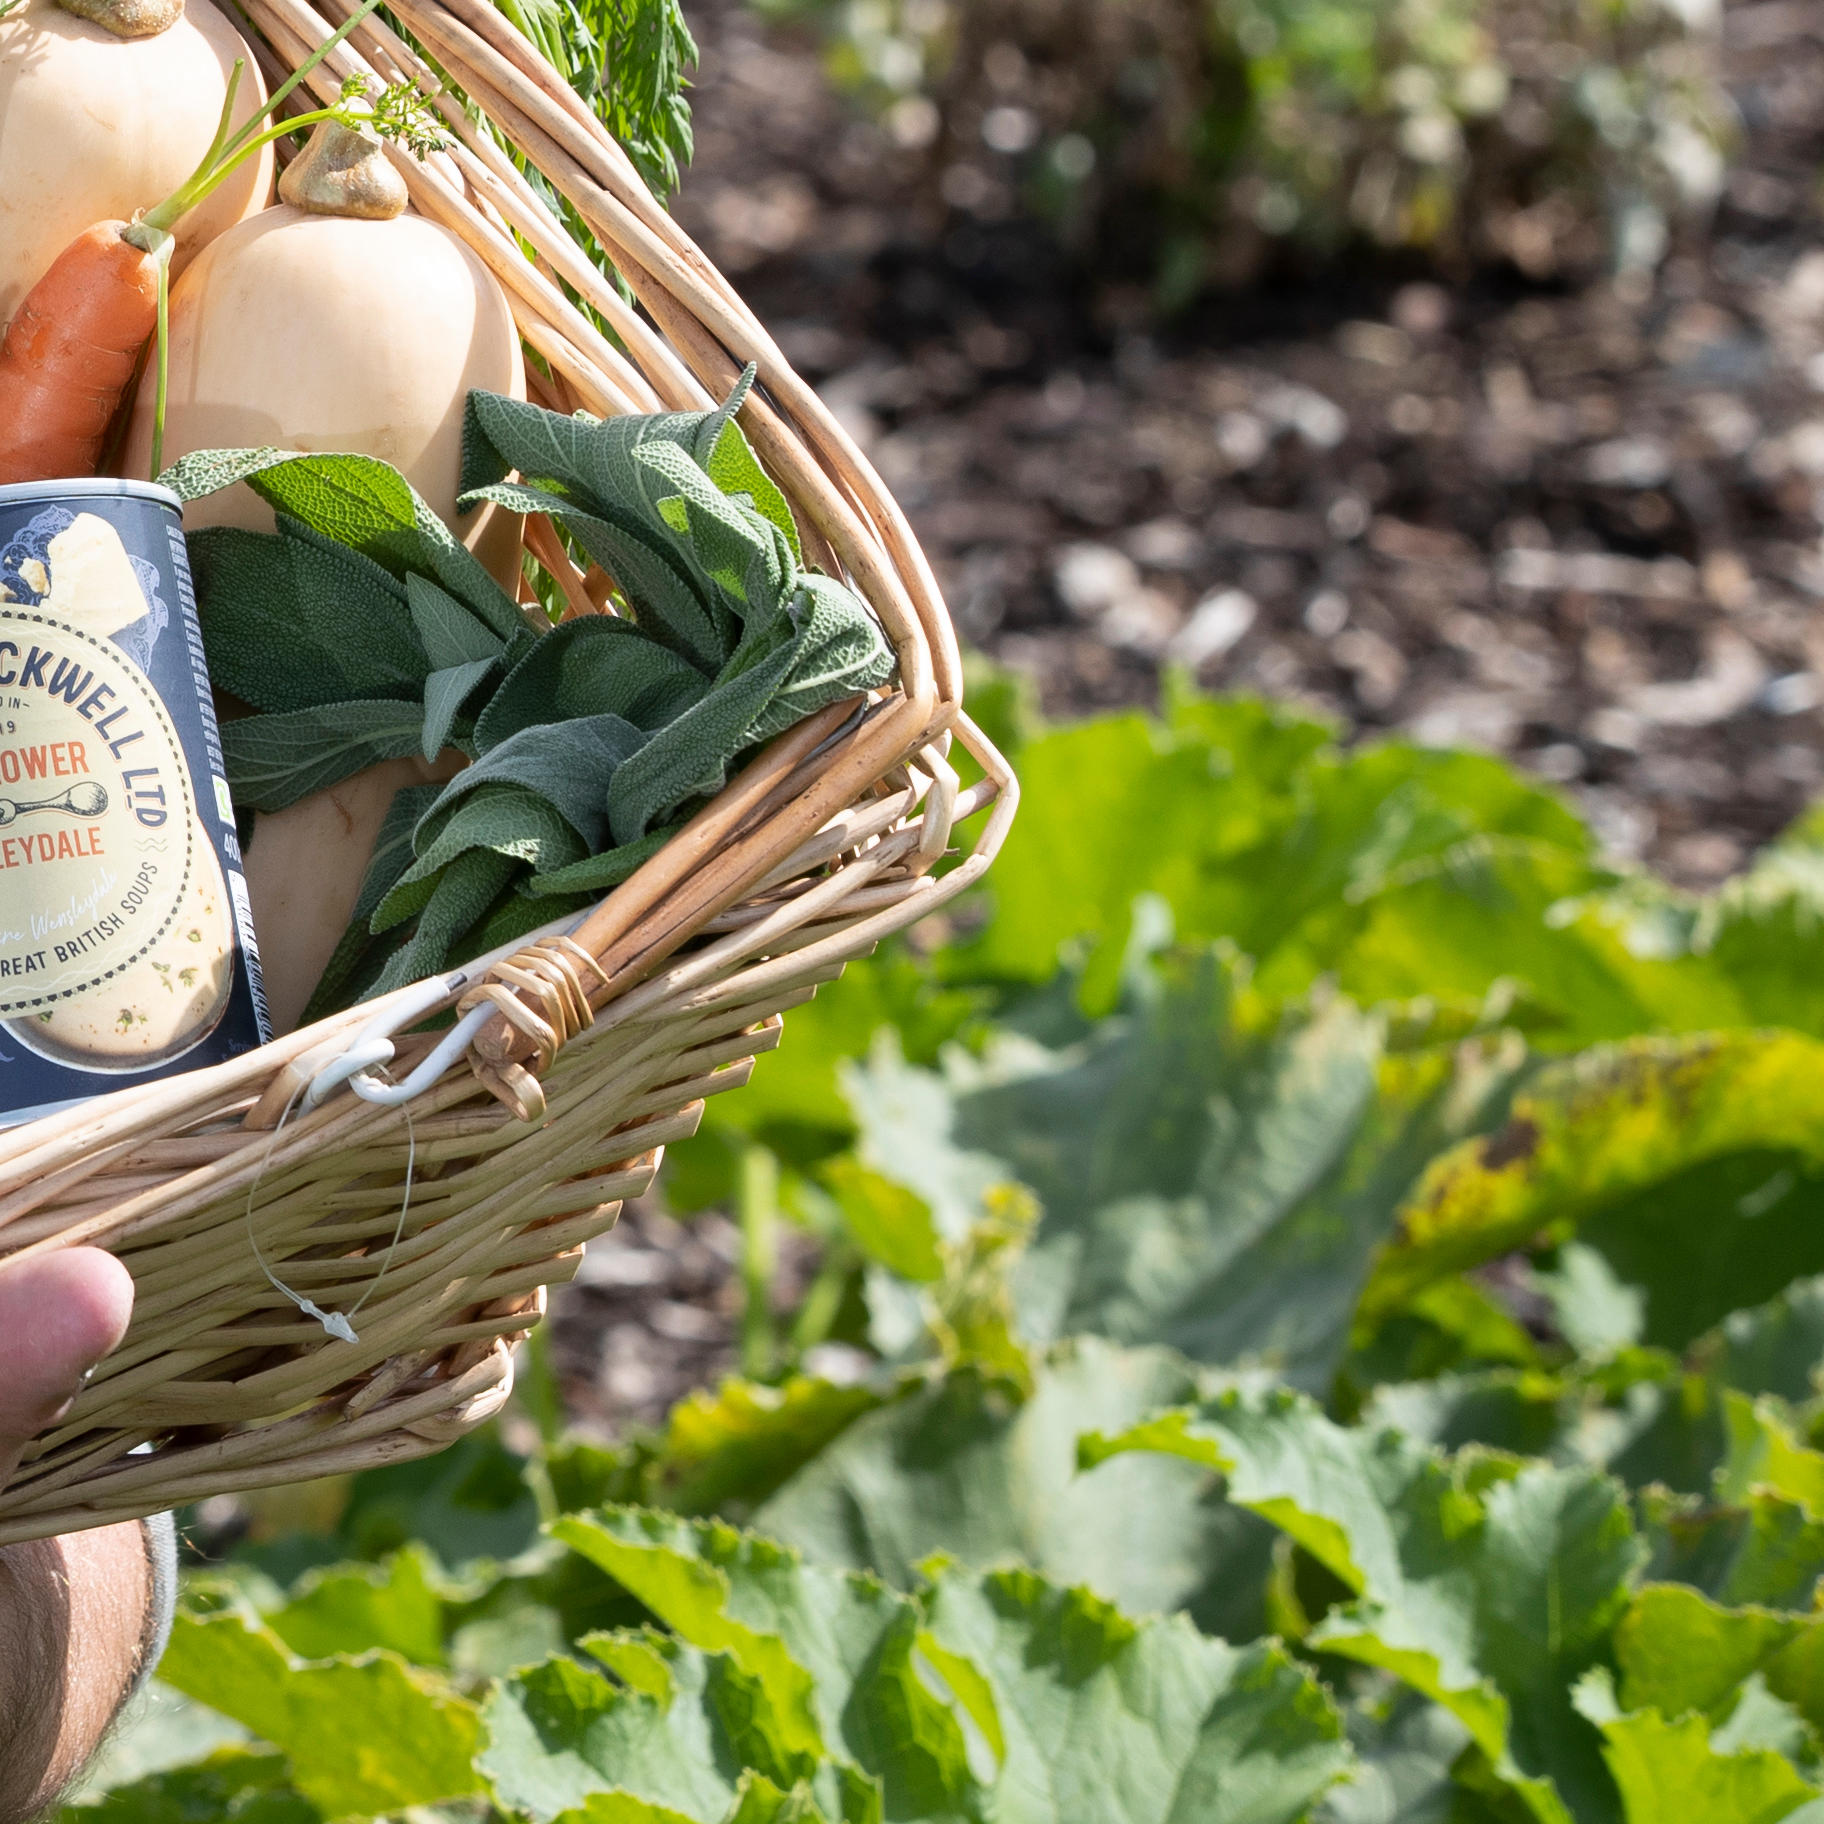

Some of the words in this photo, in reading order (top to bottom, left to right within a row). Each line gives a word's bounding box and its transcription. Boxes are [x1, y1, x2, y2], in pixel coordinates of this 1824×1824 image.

[121, 767, 168, 828] LTD
[30, 867, 118, 942] Wensleydale
[54, 912, 125, 963] BRITISH
[121, 861, 158, 915] SOUPS
